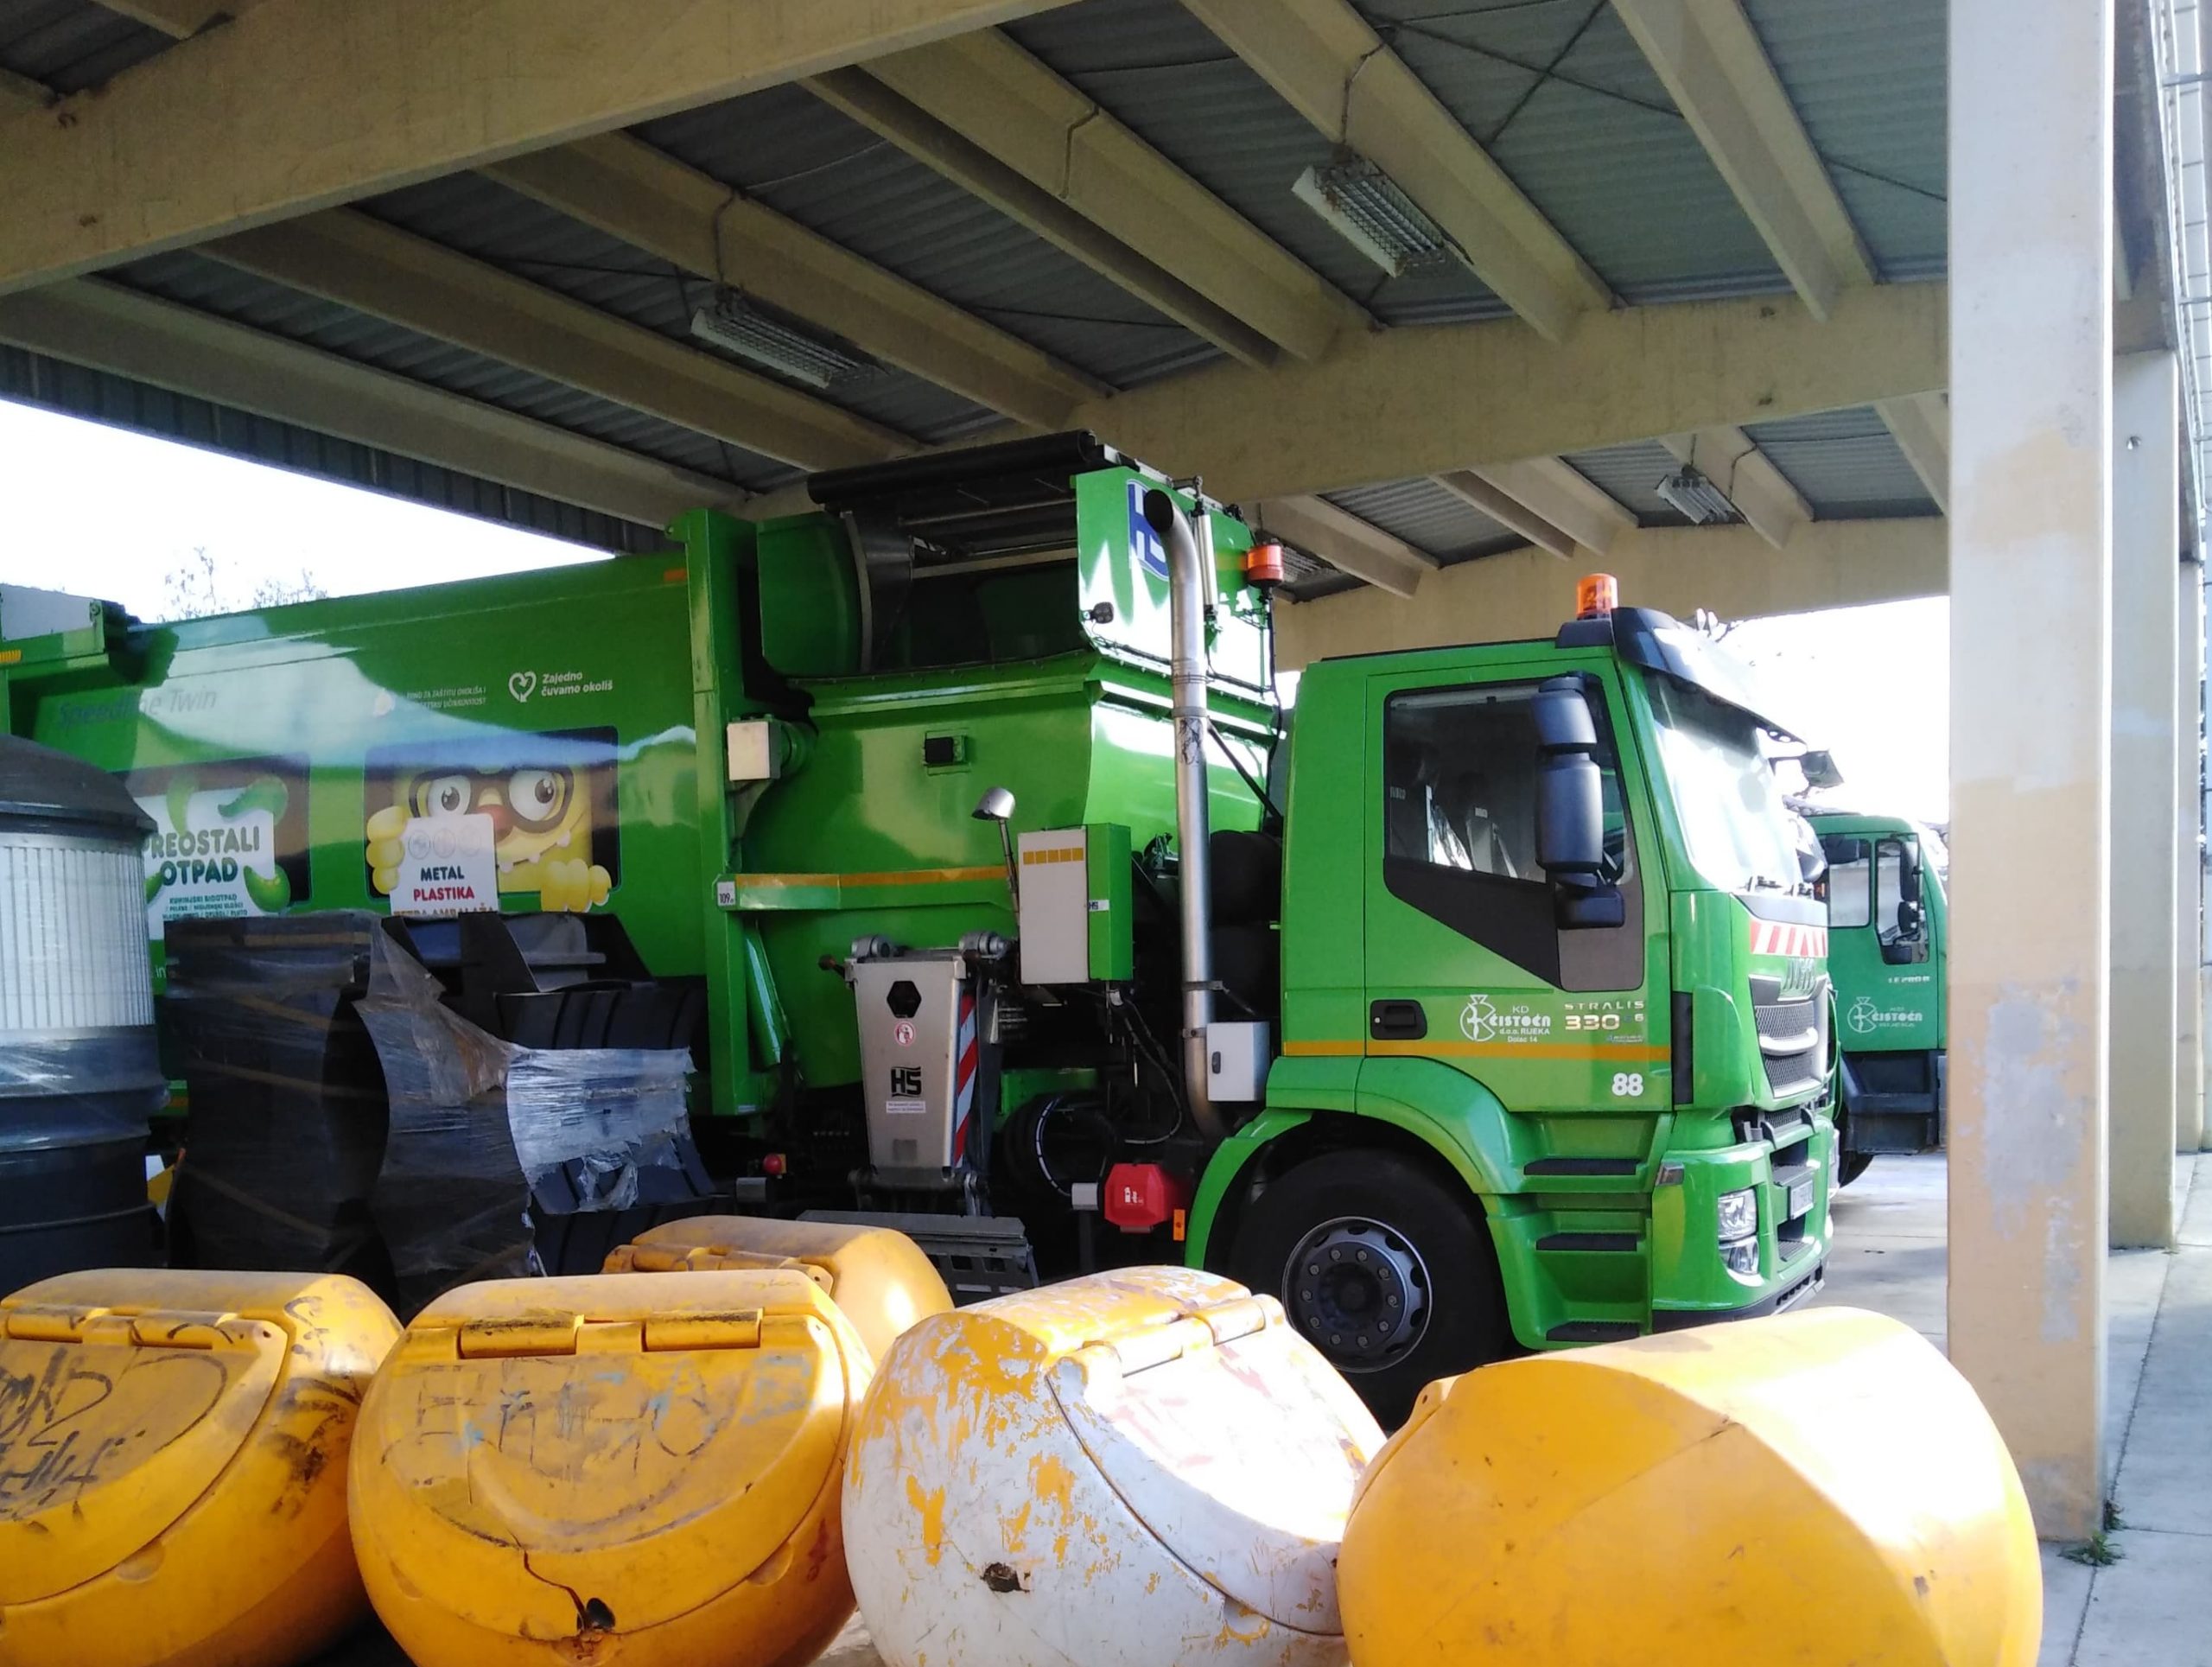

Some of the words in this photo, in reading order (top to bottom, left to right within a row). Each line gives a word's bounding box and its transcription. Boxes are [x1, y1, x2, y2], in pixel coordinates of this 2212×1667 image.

[543, 671, 582, 684] Zajedno
[541, 684, 581, 697] čuvamo
[583, 679, 613, 692] okoliš
[170, 685, 217, 713] Twin
[160, 857, 238, 887] OTPAD
[421, 866, 465, 881] METAL
[413, 885, 475, 901] PLASTIKA
[719, 893, 731, 904] 109
[1512, 1005, 1529, 1014] KD
[1564, 1001, 1645, 1010] STRALIS
[1565, 1014, 1620, 1031] 330
[1520, 1027, 1551, 1035] RIJEKA
[890, 1068, 922, 1097] HS
[1611, 1072, 1644, 1097] 88
